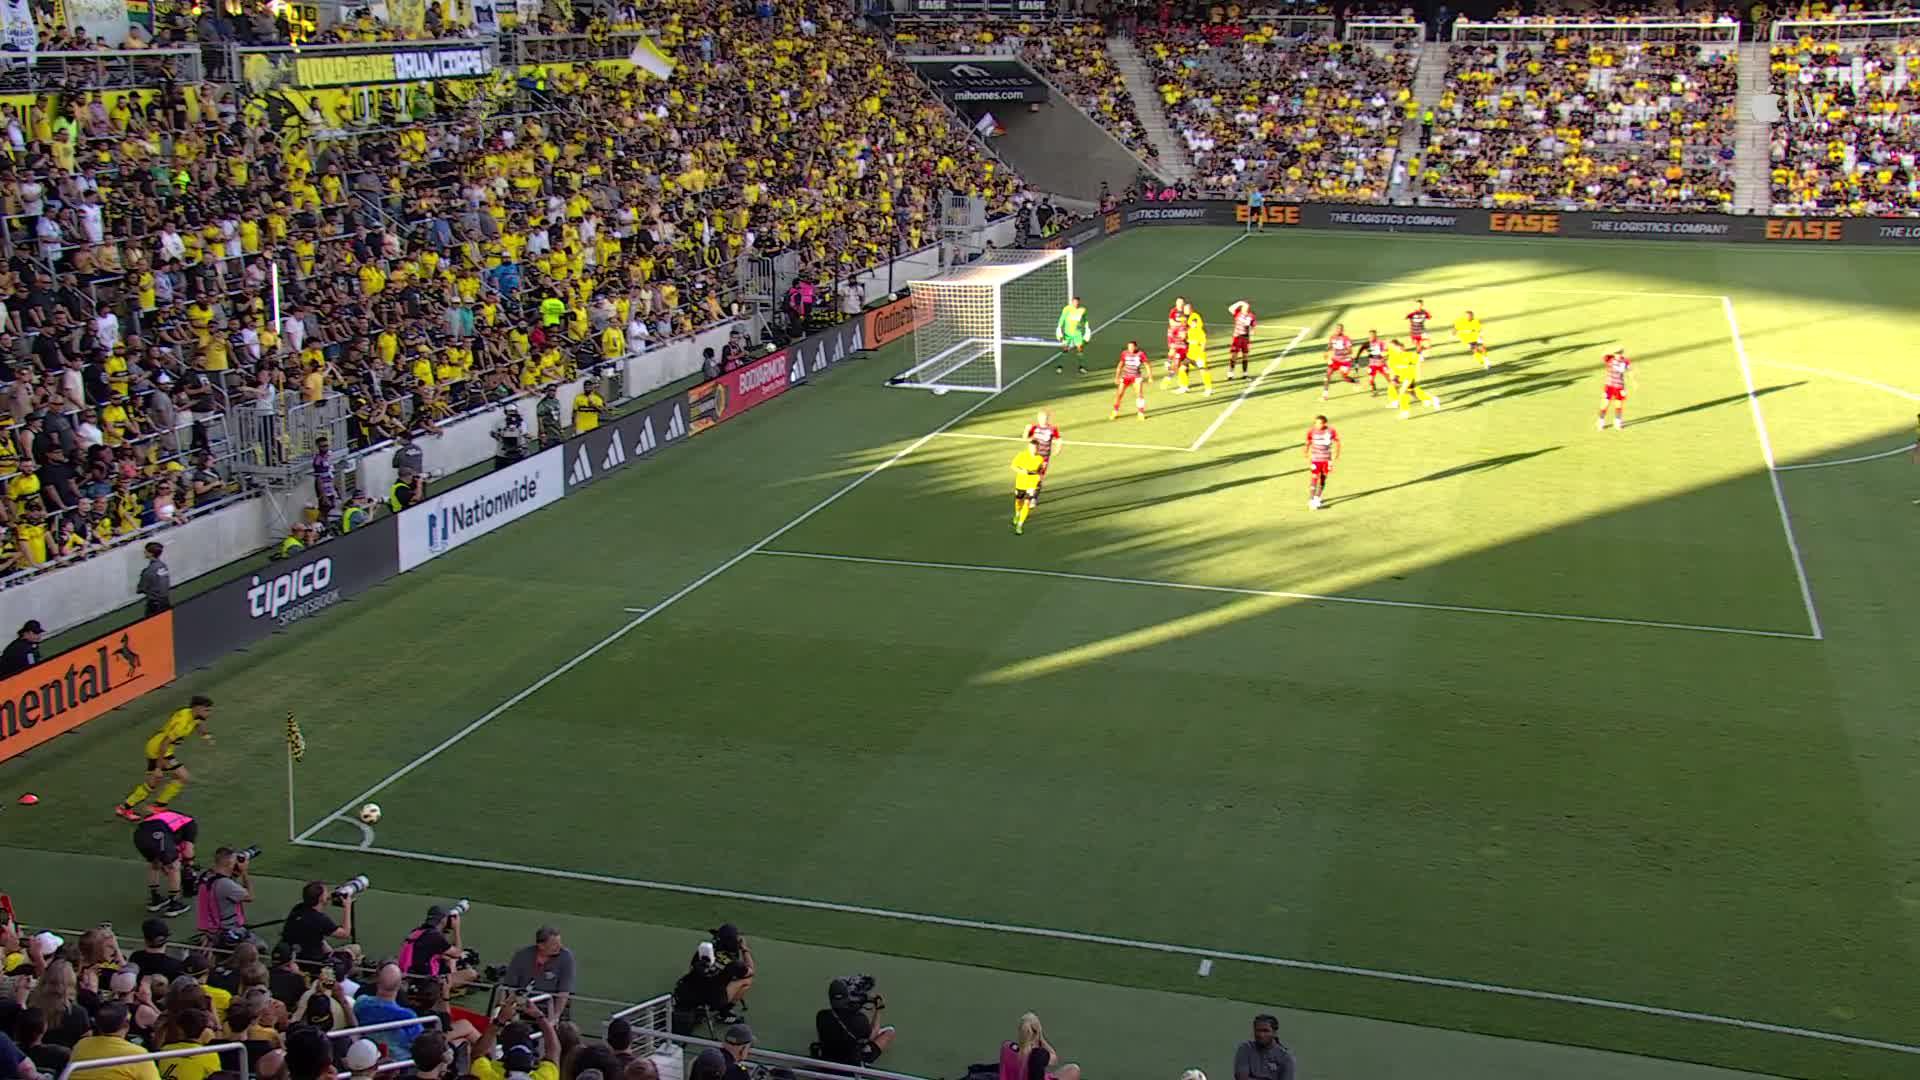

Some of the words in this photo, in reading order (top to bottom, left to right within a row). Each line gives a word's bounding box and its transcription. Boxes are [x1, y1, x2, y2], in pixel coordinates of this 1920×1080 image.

[954, 90, 1024, 101] mihomes.com
[1161, 208, 1208, 220] COMPANY
[1330, 213, 1350, 223] THE
[1351, 213, 1404, 225] LOGISTICS
[1405, 214, 1457, 227] COMPANY
[1489, 213, 1561, 233] EASE
[1591, 220, 1613, 231] THE
[1613, 220, 1671, 233] LOGISTICS
[1672, 222, 1729, 234] COMPANY
[1765, 219, 1842, 240] EASE
[1879, 226, 1903, 238] THE
[452, 474, 537, 533] Nationwide
[279, 588, 340, 626] SPORTSBOOK
